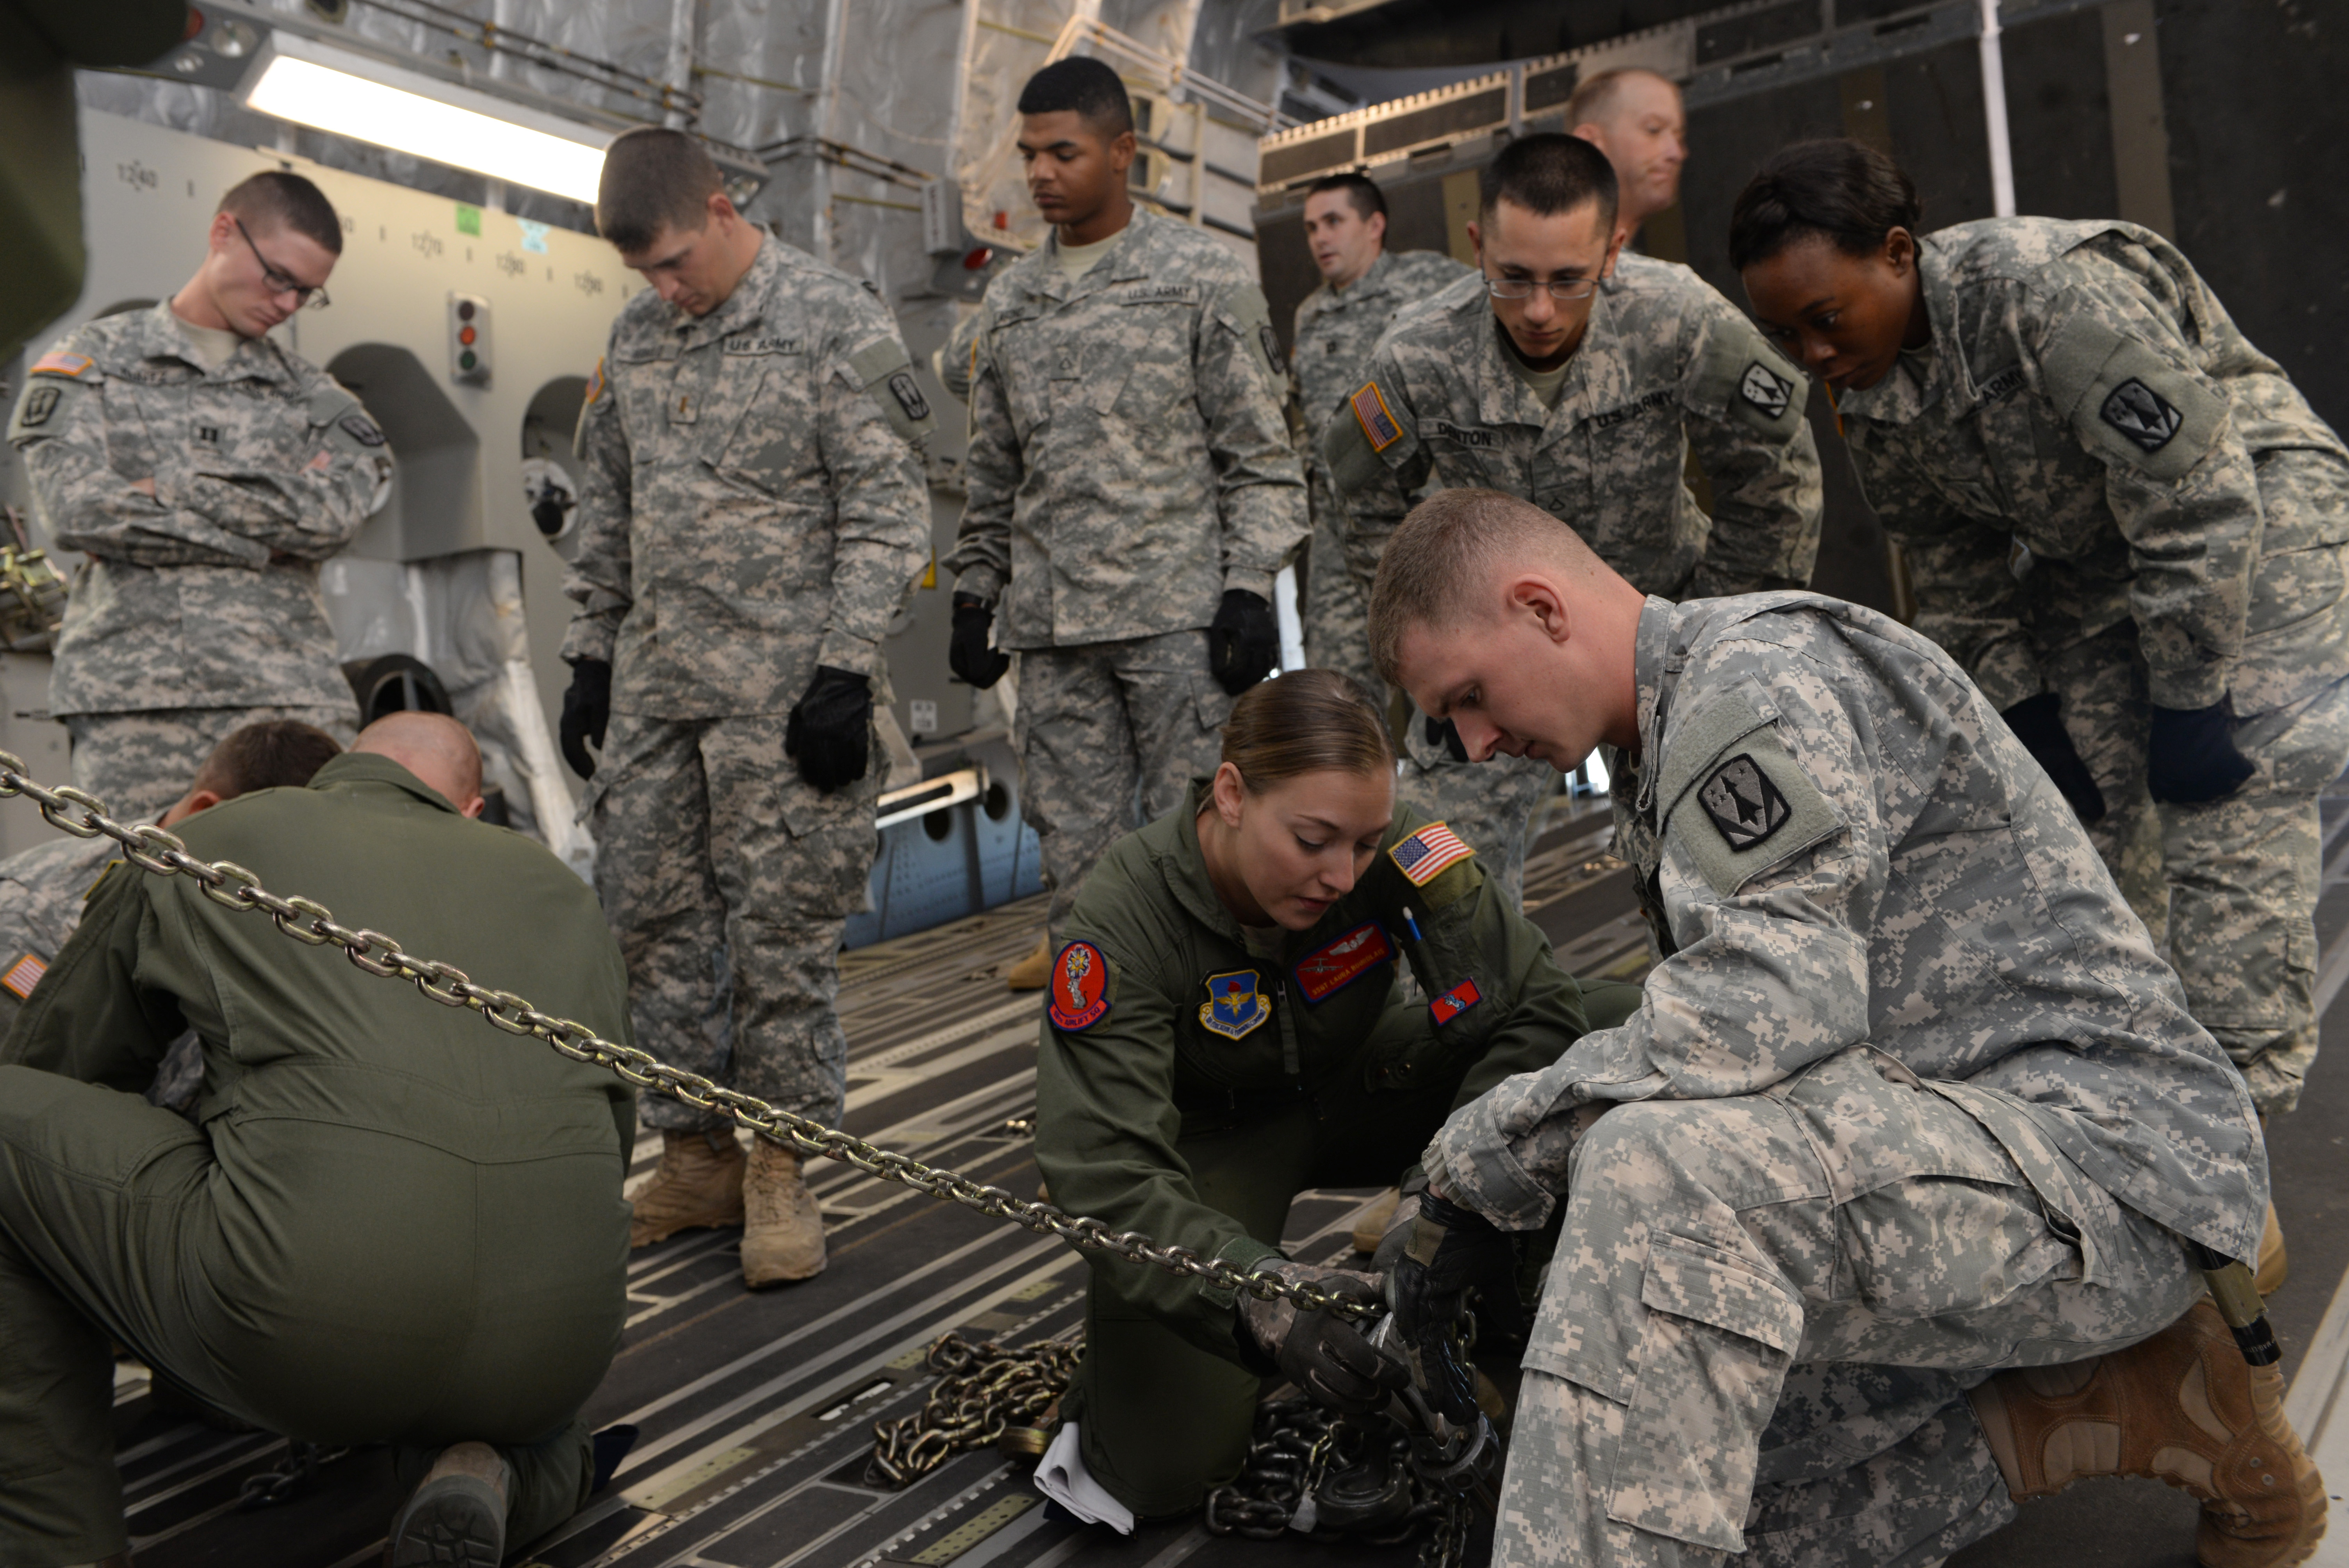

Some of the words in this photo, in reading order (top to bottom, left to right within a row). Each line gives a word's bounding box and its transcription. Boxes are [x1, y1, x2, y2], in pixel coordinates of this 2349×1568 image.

[1155, 286, 1190, 298] ARMY
[758, 338, 796, 350] ARMY
[1631, 389, 1674, 419] ARMY
[1438, 422, 1492, 446] DENTON
[1312, 982, 1328, 996] SSGT
[1329, 969, 1351, 986] LAURA
[1064, 1015, 1089, 1026] AIRLIFT
[1090, 1007, 1101, 1017] SQ
